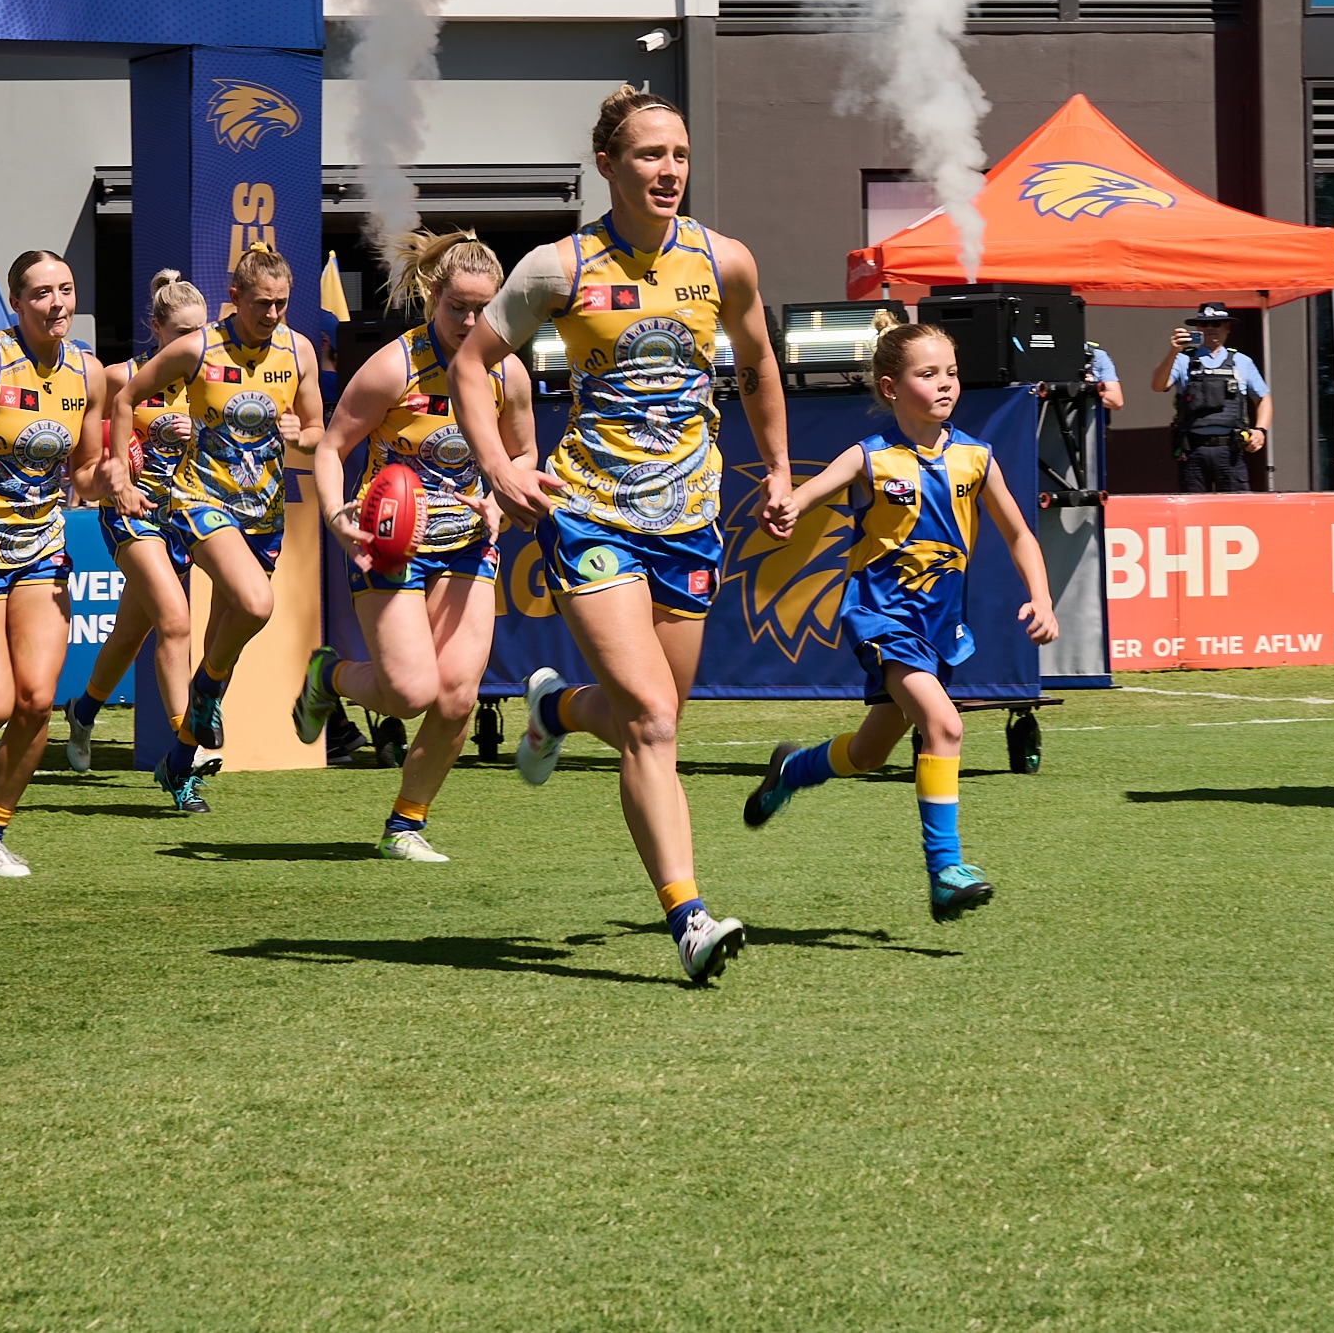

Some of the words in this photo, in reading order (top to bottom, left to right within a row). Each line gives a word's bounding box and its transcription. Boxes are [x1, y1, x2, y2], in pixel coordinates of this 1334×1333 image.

[675, 285, 710, 301] BHP
[264, 370, 292, 383] BHP
[62, 398, 85, 411] BHP
[956, 482, 977, 498] BH
[1104, 525, 1260, 599] BHP
[1153, 638, 1185, 656] OF
[1197, 635, 1243, 655] THE
[1254, 633, 1322, 653] AFLW
